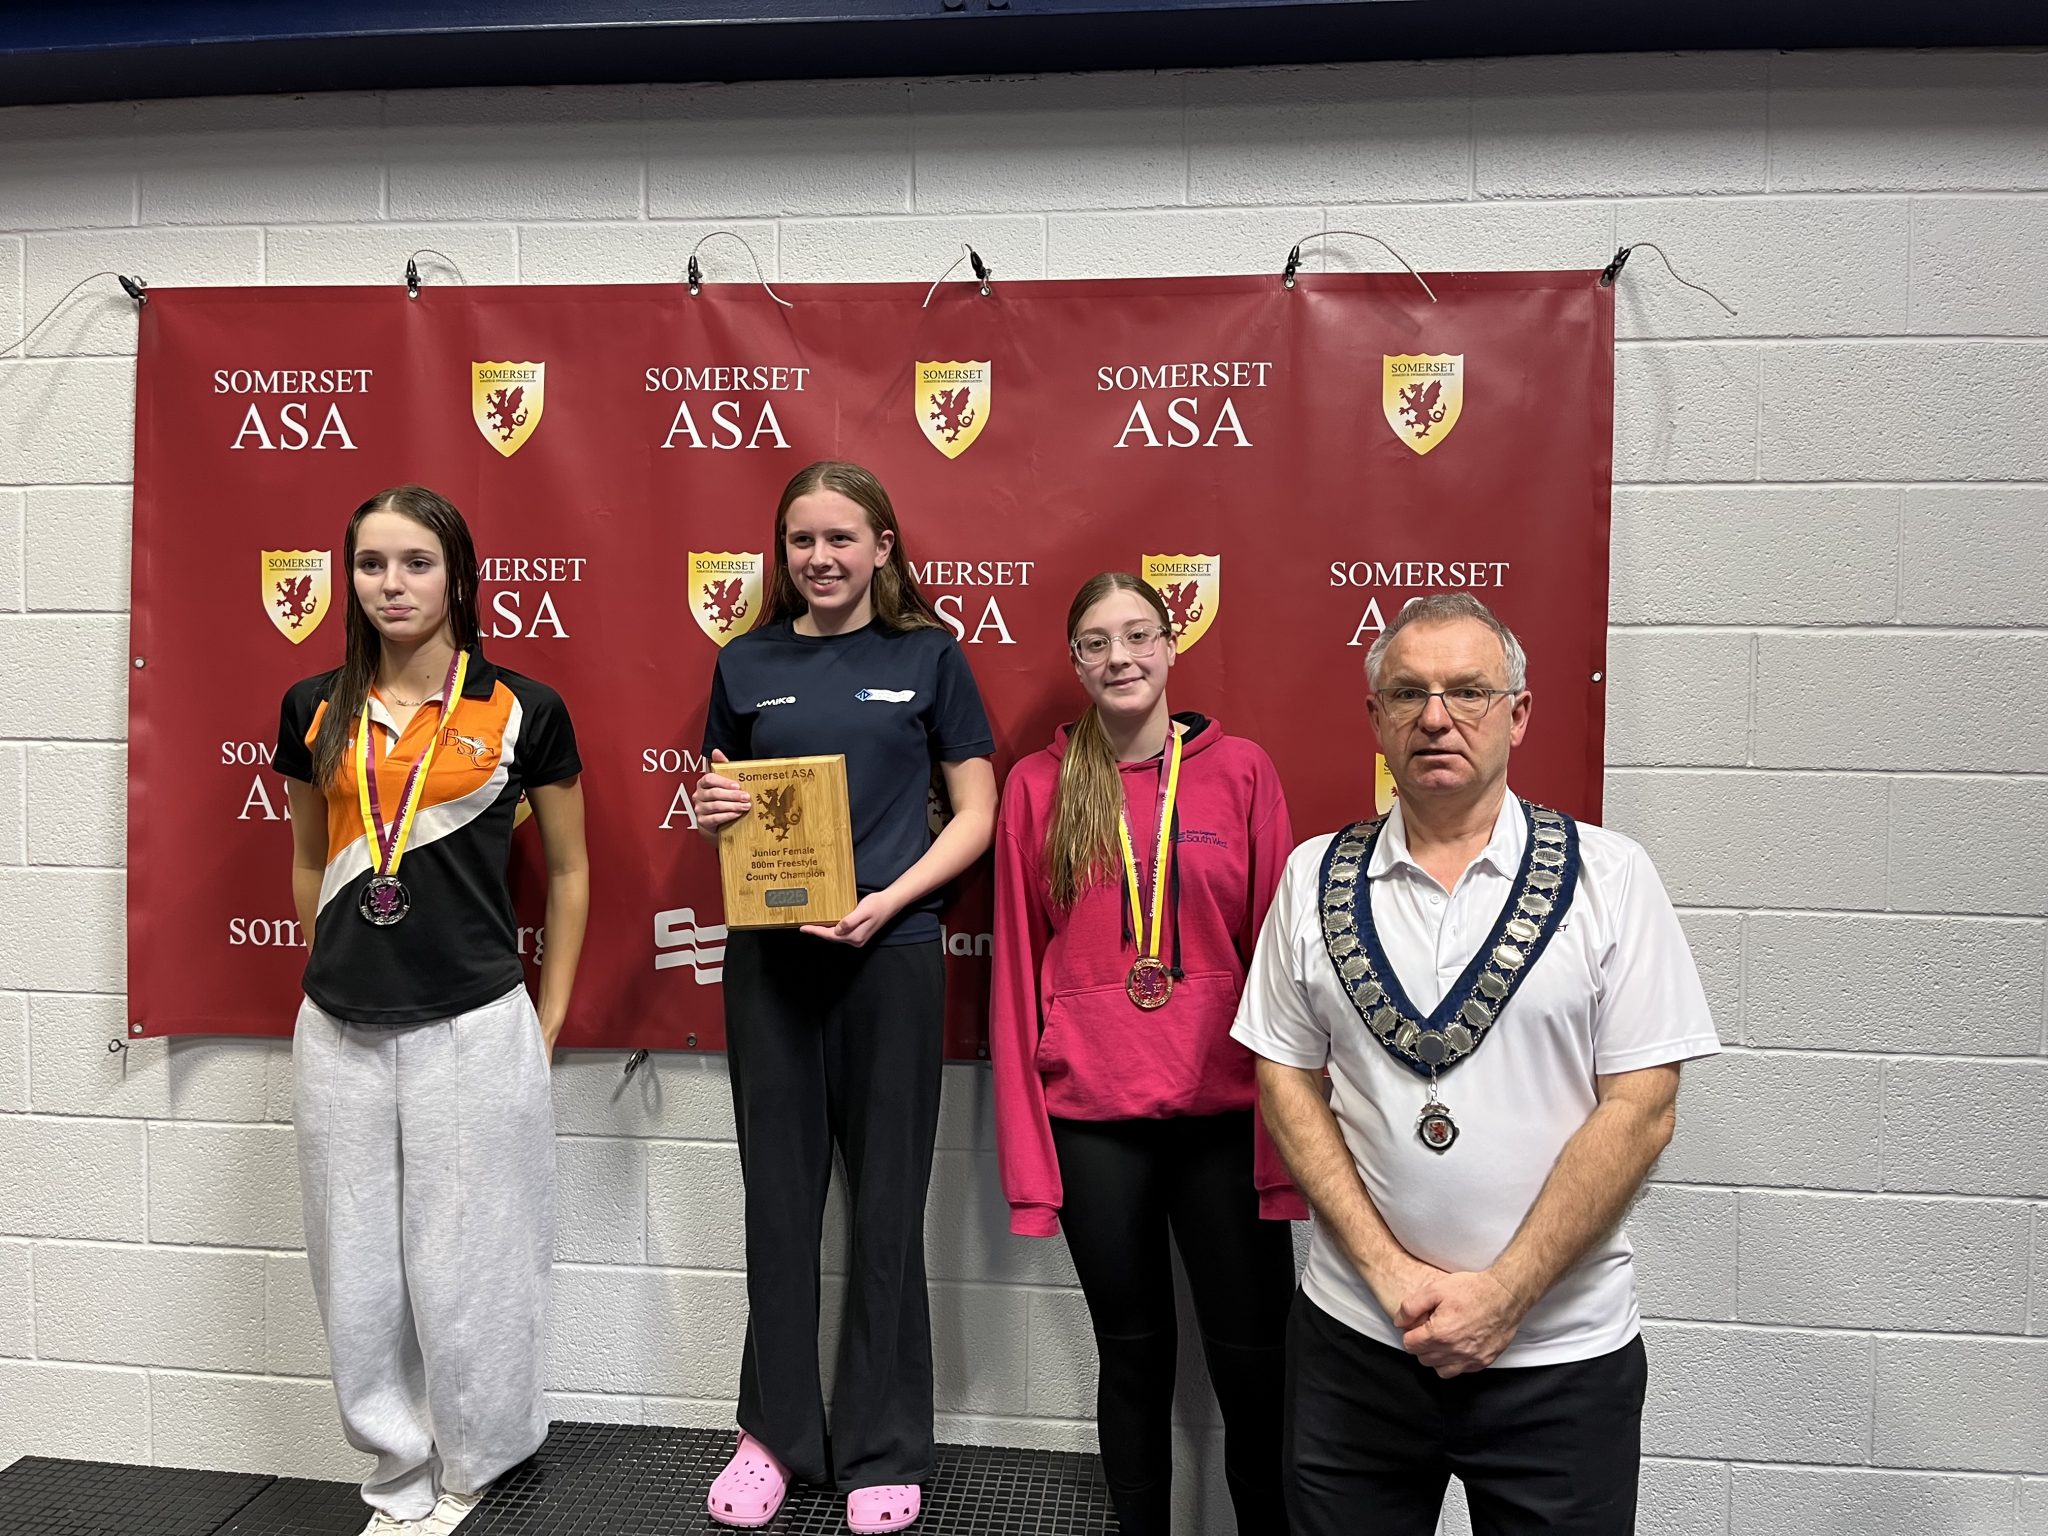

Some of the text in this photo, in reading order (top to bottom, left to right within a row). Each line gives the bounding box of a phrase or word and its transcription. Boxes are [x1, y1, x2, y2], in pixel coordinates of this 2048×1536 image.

[479, 369, 537, 379] SOMERSET
[923, 369, 983, 380] SOMERSET
[1098, 362, 1273, 391] SOMERSET
[1390, 362, 1455, 373] SOMERSET
[214, 369, 373, 394] SOMERSET
[645, 366, 810, 392] SOMERSET
[230, 403, 358, 450] ASA
[660, 400, 792, 449] ASA
[1113, 397, 1253, 448] ASA
[268, 558, 323, 568] SOMERSET
[479, 557, 587, 582] MERSET
[695, 560, 755, 570] SOMERSET
[1150, 563, 1211, 573] SOMERSET
[908, 561, 1035, 586] MERSET
[1330, 561, 1510, 587] SOMERSET
[479, 590, 570, 639] SA
[934, 595, 1017, 644] SA
[738, 768, 815, 782] Somerset ASA
[1186, 834, 1212, 844] South
[752, 846, 815, 857] Junior Female
[751, 858, 818, 869] 800m Freestyle
[746, 870, 825, 881] County Champion
